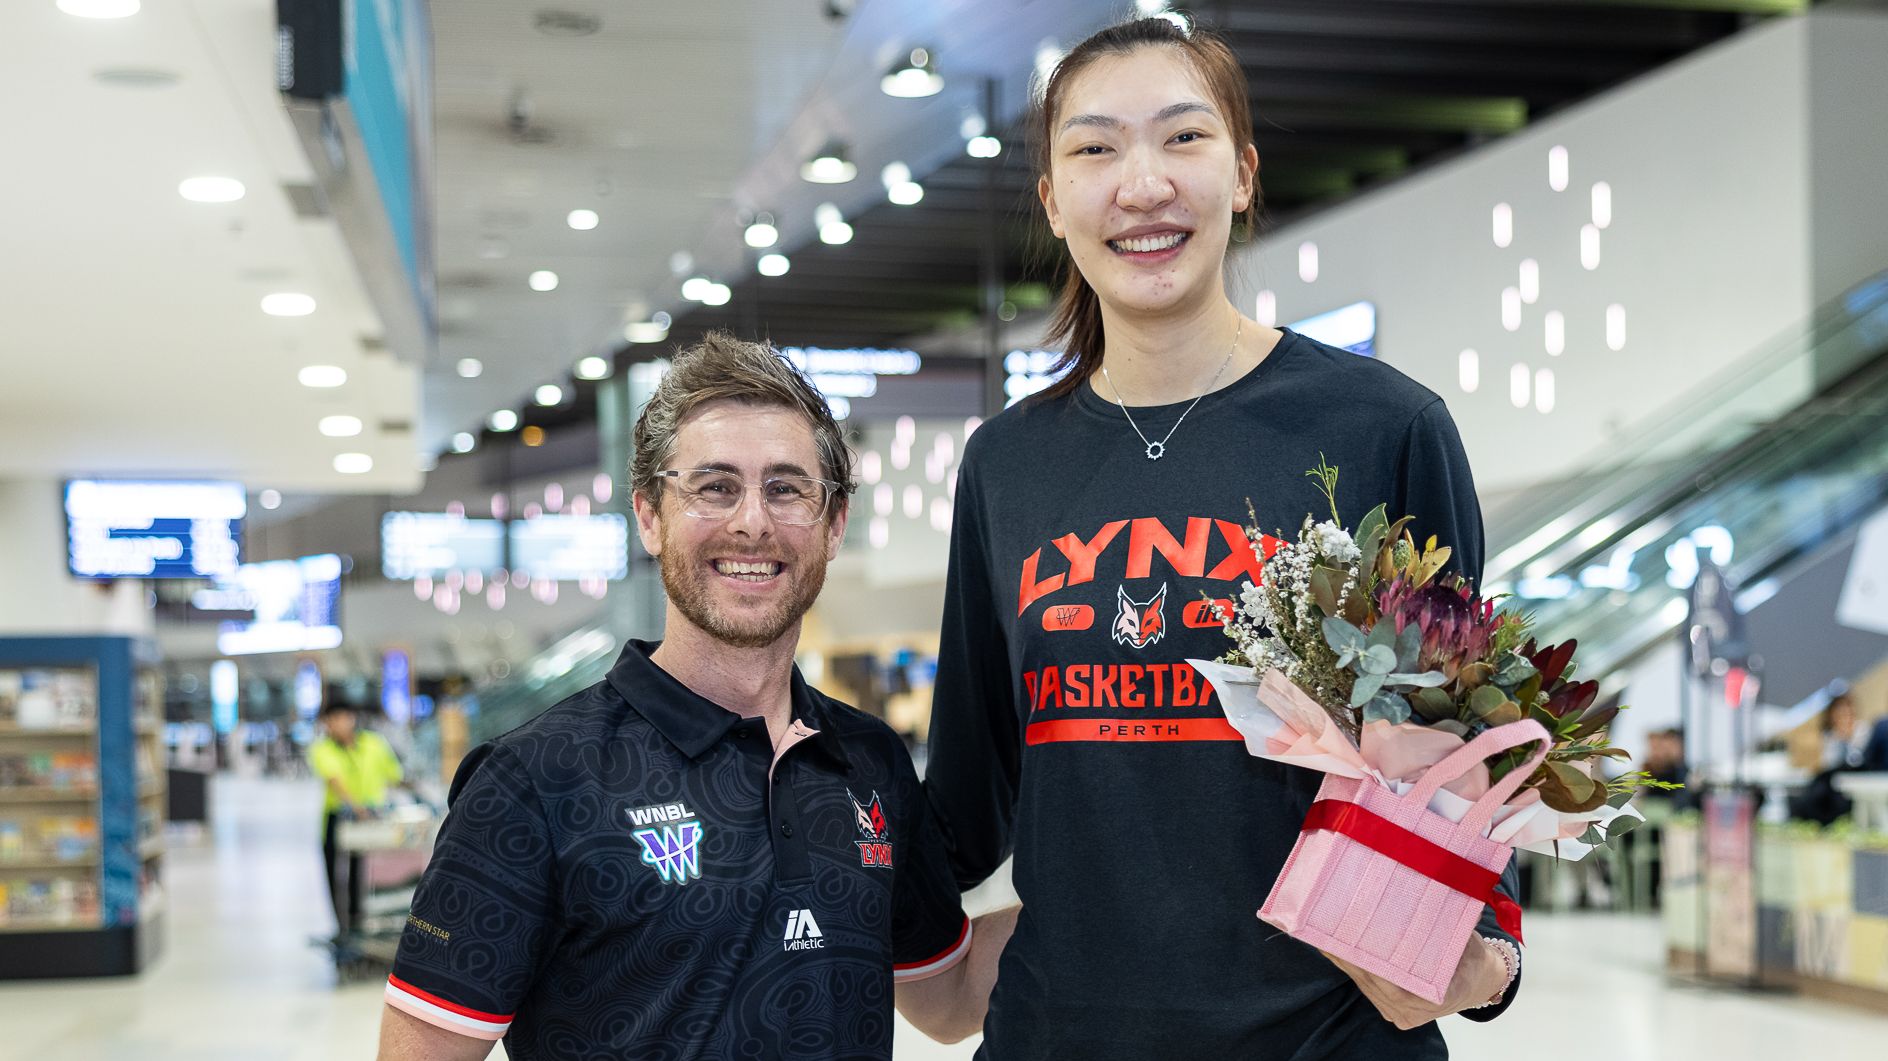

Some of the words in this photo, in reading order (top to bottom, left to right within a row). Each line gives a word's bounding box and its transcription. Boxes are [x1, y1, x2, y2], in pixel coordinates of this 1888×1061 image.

[1018, 516, 1289, 618] LYNX
[1099, 724, 1180, 736] PERTH
[629, 803, 695, 825] WNBL
[432, 926, 450, 941] STAR
